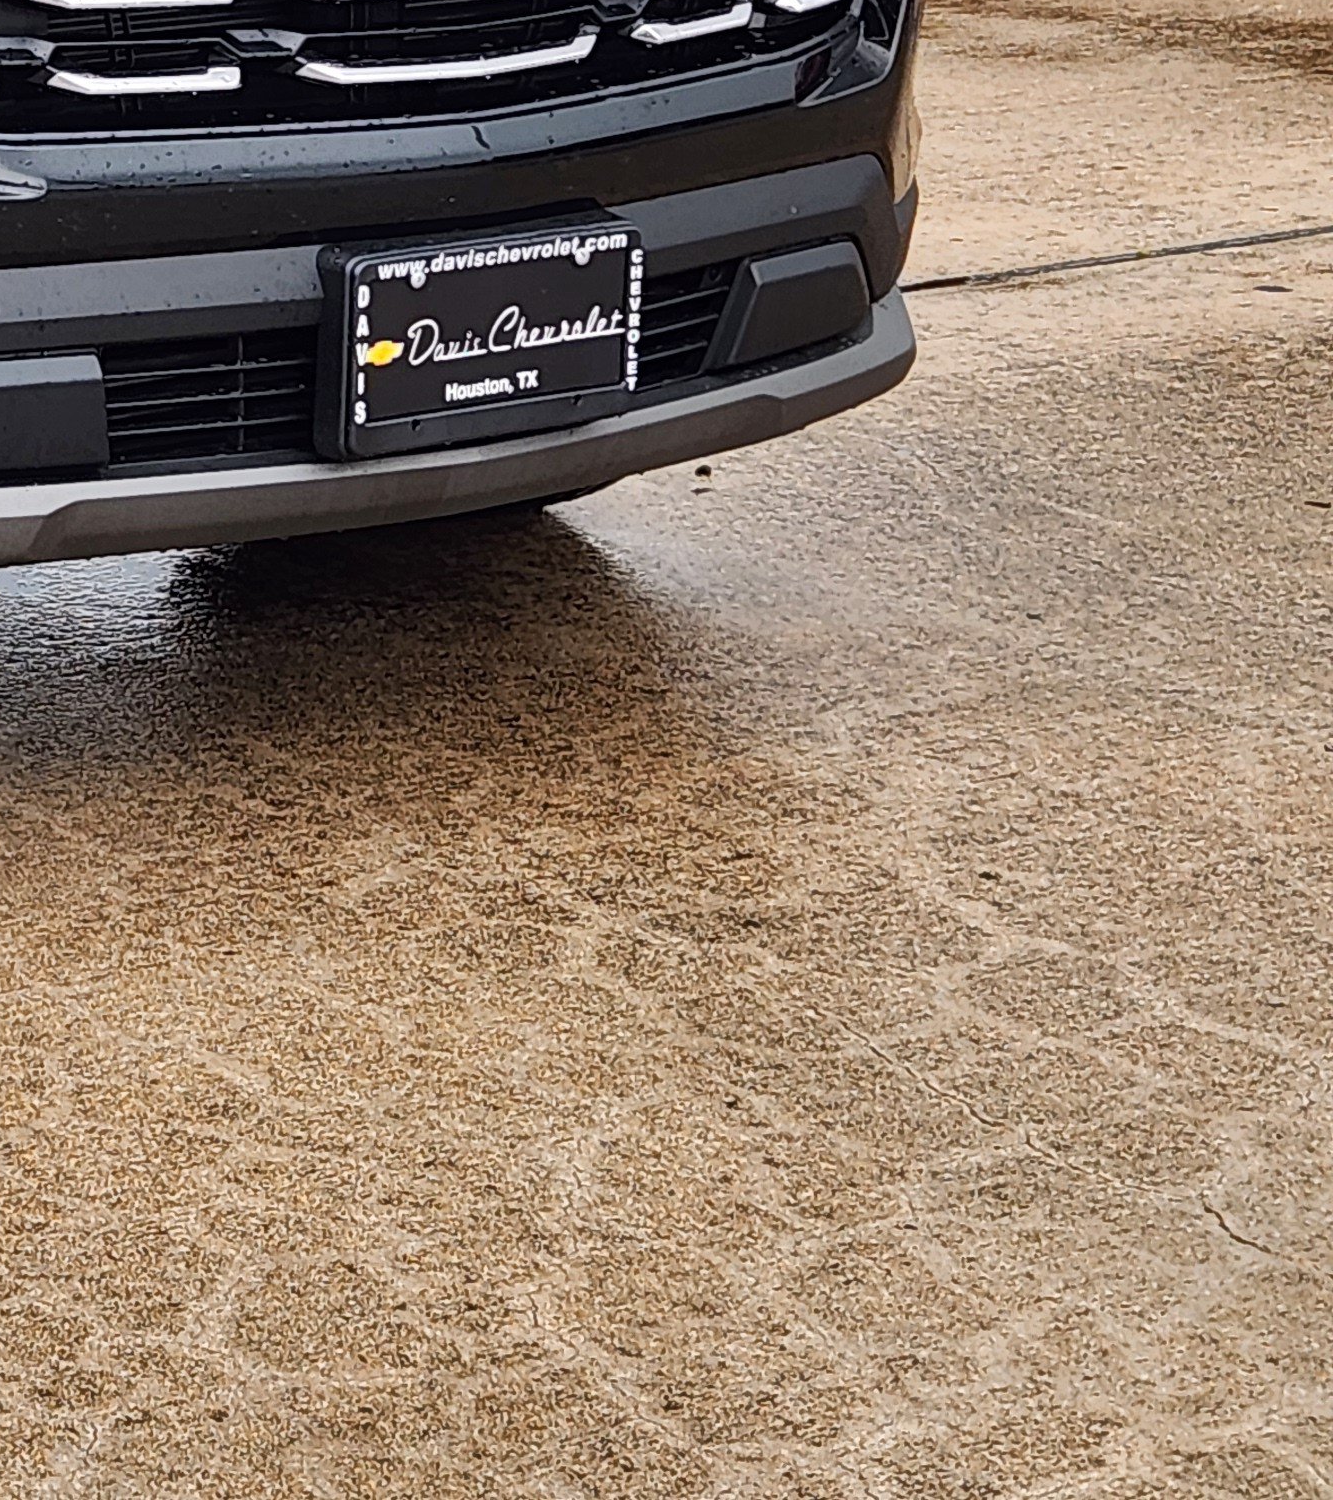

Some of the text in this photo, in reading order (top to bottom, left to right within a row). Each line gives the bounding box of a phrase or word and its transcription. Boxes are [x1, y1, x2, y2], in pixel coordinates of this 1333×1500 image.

[377, 233, 628, 280] www.davischevrolet.com
[407, 305, 626, 367] Davis Chevrolet
[625, 248, 644, 391] CHEVROLET
[354, 284, 372, 426] DAVIS
[445, 370, 539, 402] Houston, TX
